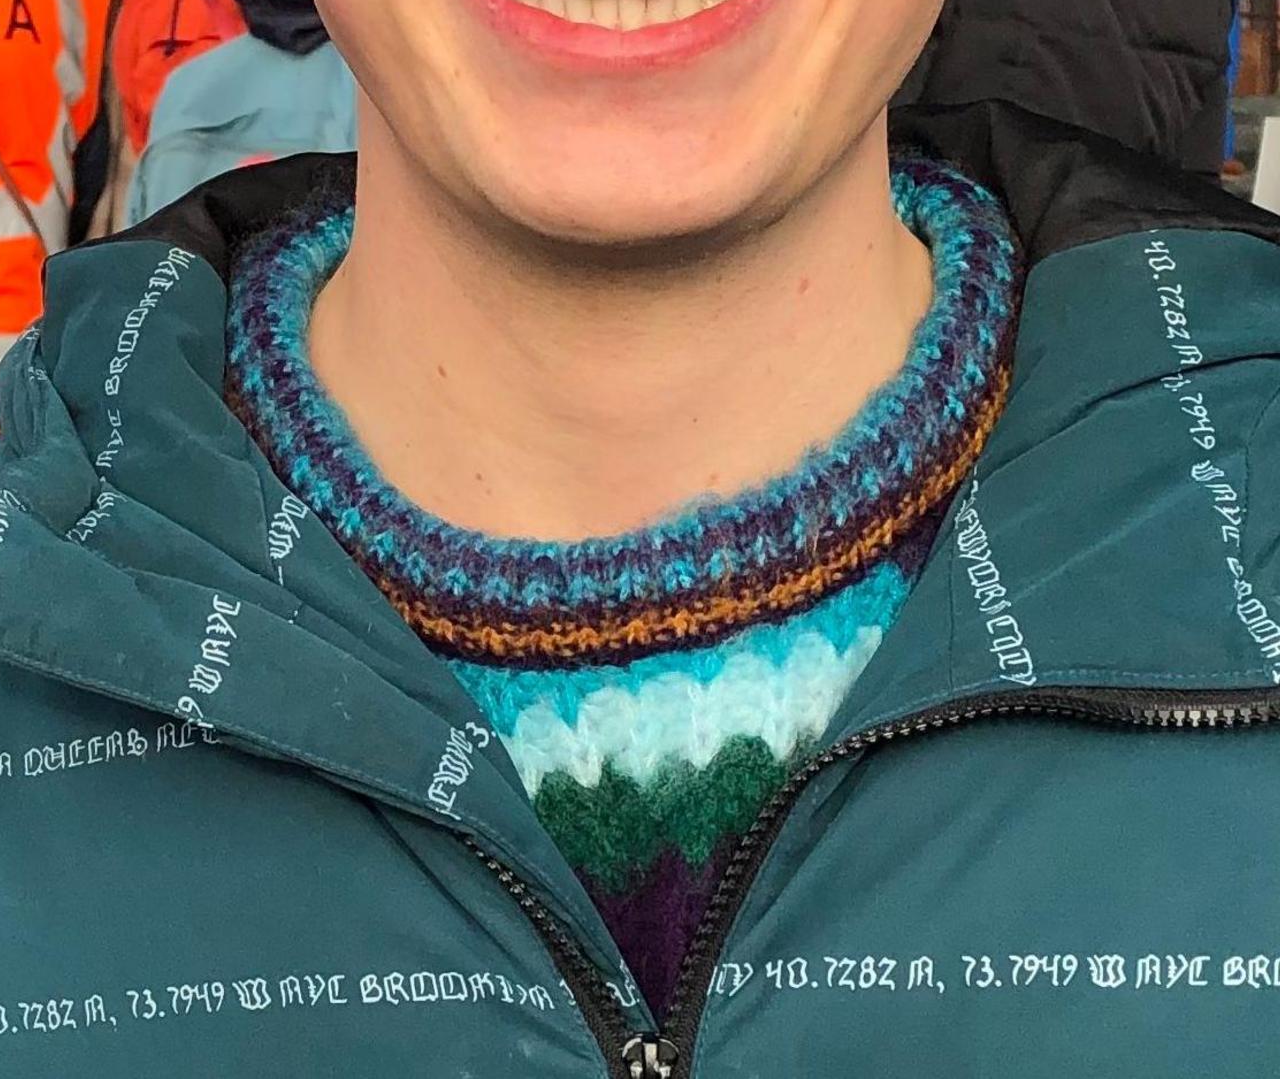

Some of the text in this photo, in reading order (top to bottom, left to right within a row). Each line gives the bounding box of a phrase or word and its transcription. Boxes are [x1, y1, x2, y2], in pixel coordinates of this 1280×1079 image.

[765, 956, 897, 992] 40.7282
[961, 954, 1078, 989] 73.7949
[125, 981, 225, 1019] 73.7949
